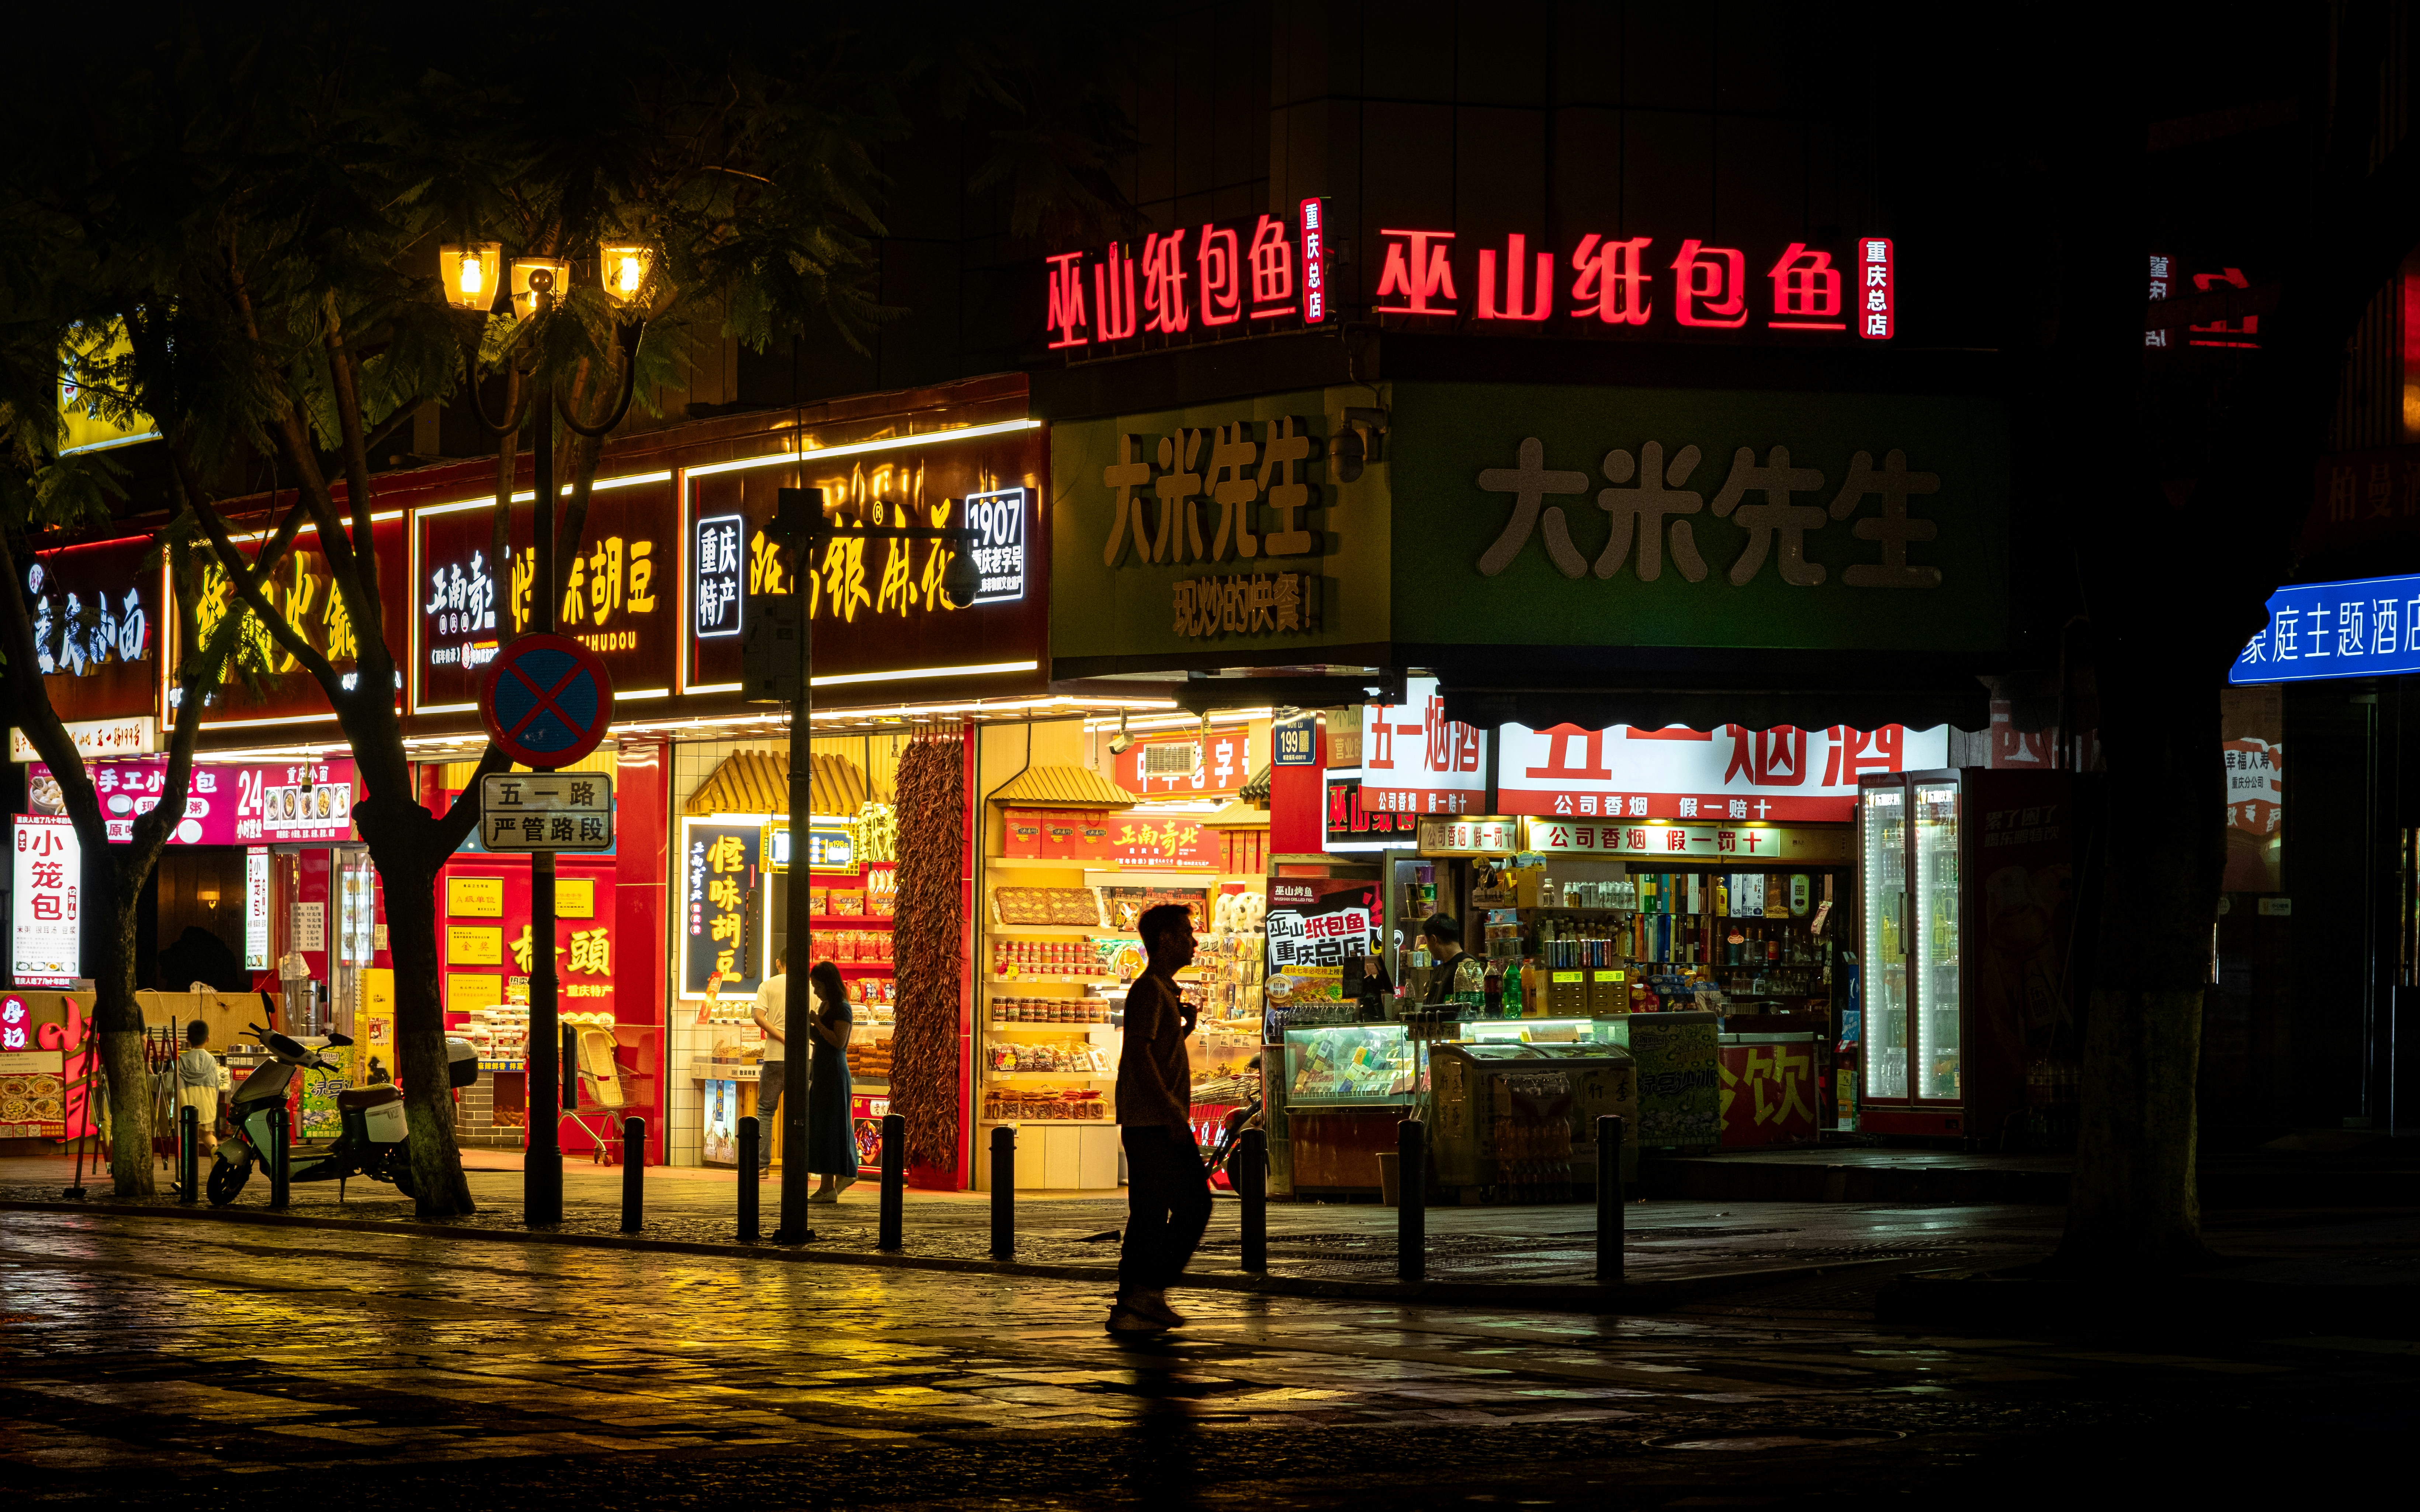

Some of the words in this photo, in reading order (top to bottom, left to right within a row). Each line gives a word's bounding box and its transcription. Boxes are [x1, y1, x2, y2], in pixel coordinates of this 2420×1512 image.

[1304, 203, 1321, 318] 重庆总店
[1046, 214, 1296, 349] 巫山纸包鱼
[1376, 229, 1846, 330] 巫山纸包鱼
[1865, 240, 1887, 336] 重庆总店
[1103, 416, 1311, 567] 大米先生
[970, 499, 1020, 547] 1907
[1479, 437, 1942, 586] 大米先生
[750, 498, 955, 623] 陈银麻花
[971, 545, 1022, 574] 重庆老字号
[426, 550, 493, 631] 正南奇
[1173, 571, 1310, 636] 现炒的快餐!
[1280, 731, 1298, 752] 199
[1369, 695, 1479, 772] 五一烟酒
[287, 765, 329, 784] 重庆小面
[2226, 751, 2270, 771] 幸福人寿
[98, 768, 217, 793] 手工小包
[238, 770, 263, 816] 24
[498, 781, 596, 806] 五一路
[2232, 776, 2264, 789] 重庆分公司
[1379, 792, 1417, 812] 公司香烟
[1428, 793, 1467, 813] 假一赔十
[1554, 795, 1648, 816] 公司香烟
[1679, 797, 1772, 819] 假一赔十
[19, 834, 25, 848] 手工
[237, 818, 262, 839] 小时营业
[492, 817, 604, 842] 严管路段
[1113, 820, 1199, 857] 正南奇北
[1427, 825, 1466, 847] 公司香烟
[1473, 826, 1512, 848] 假一罚十
[1549, 827, 1646, 849] 公司香烟
[1666, 830, 1762, 852] 假一罚十
[31, 830, 63, 921] 小笼包
[1275, 886, 1313, 897] 巫山烤鱼
[707, 834, 745, 982] 怪味胡豆
[1269, 913, 1366, 940] 巫山纸包鱼
[462, 941, 489, 951] 金奖
[1275, 937, 1366, 967] 重庆总店
[566, 984, 614, 997] 重庆特产
[478, 1062, 506, 1070] 麻辣鲜香
